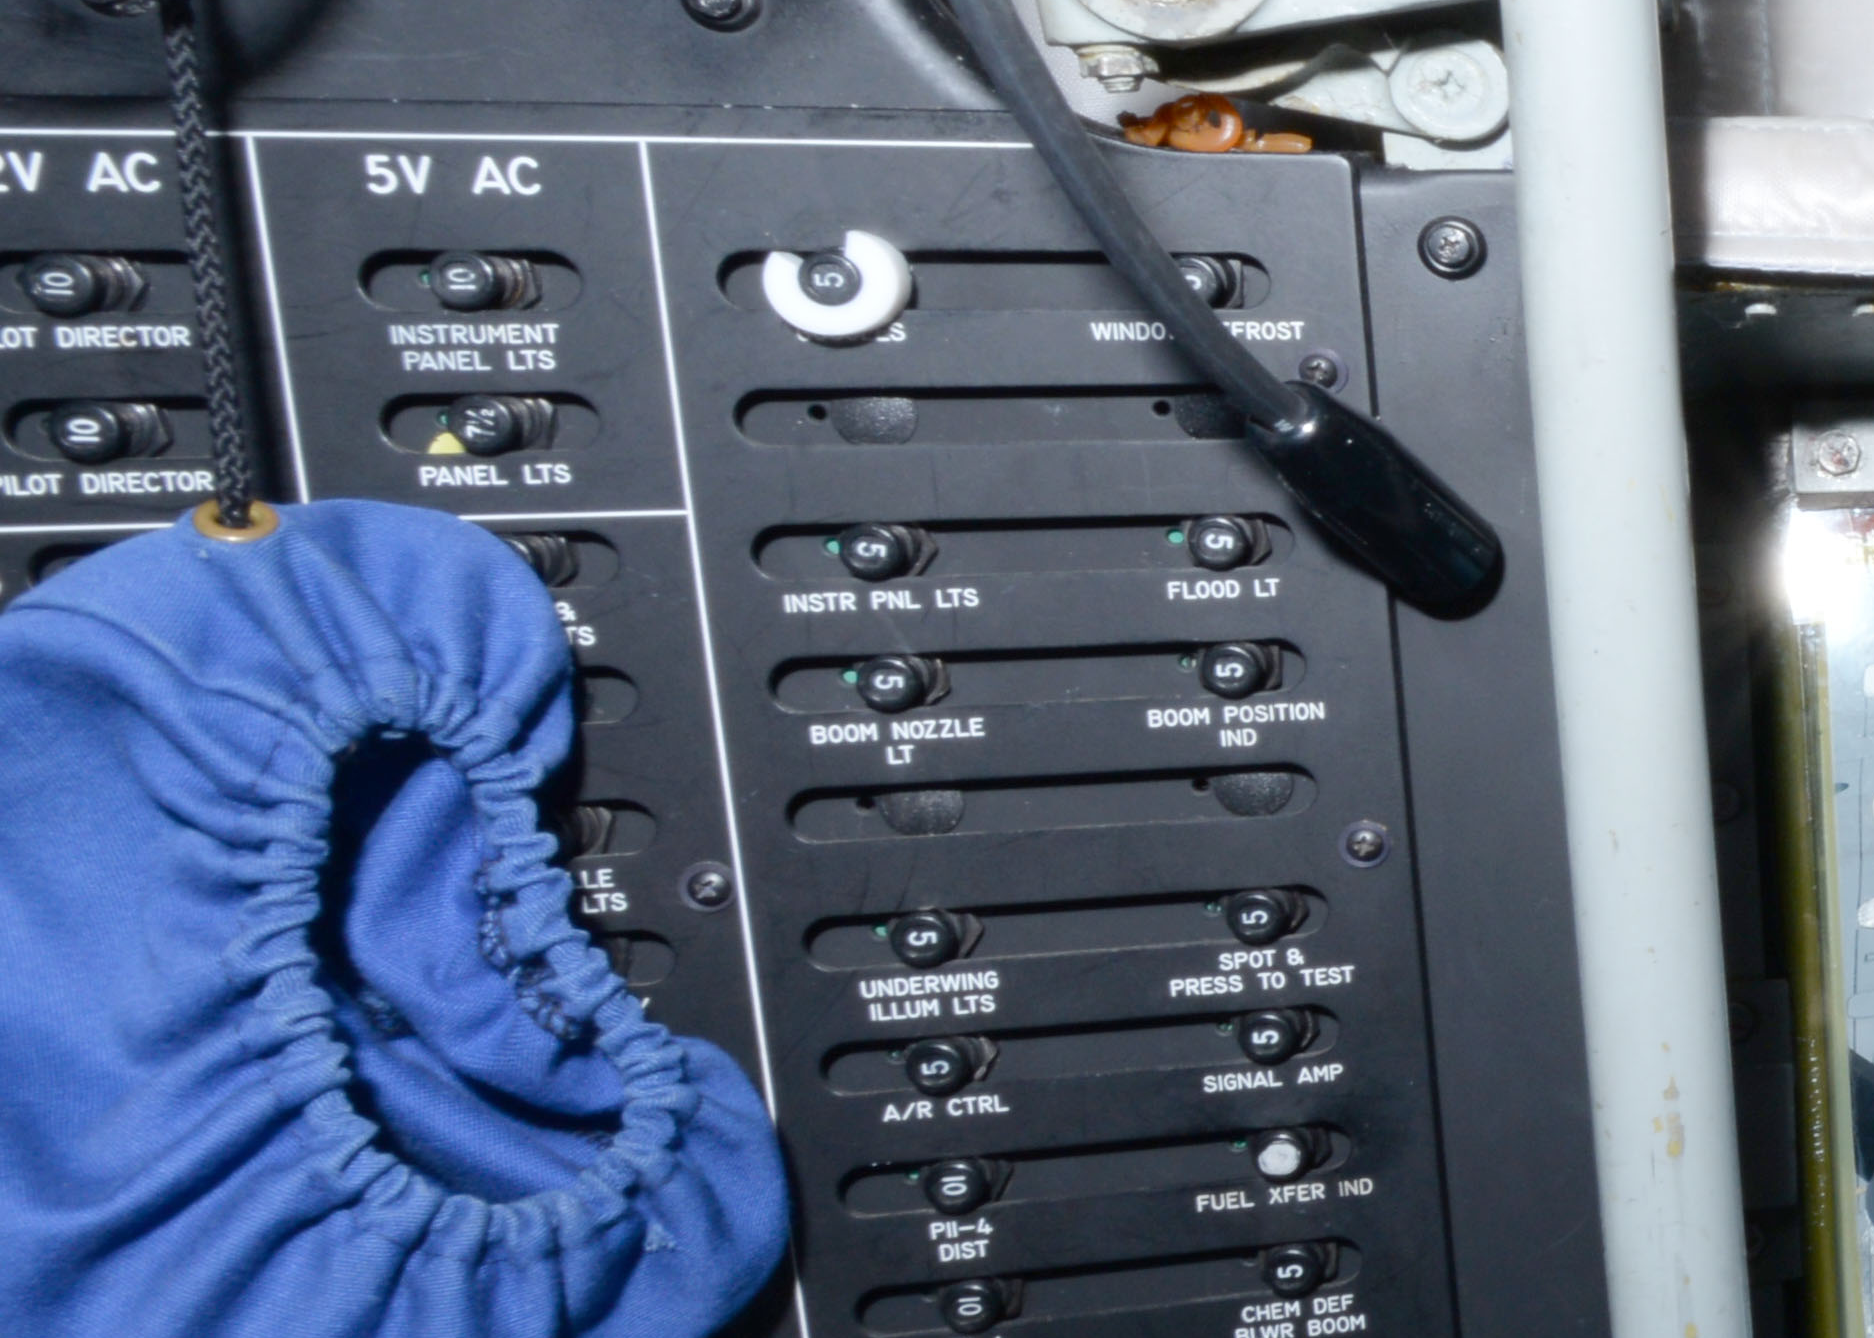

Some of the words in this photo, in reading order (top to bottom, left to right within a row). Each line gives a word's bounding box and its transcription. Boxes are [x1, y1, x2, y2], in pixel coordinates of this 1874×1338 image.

[87, 151, 161, 193] AC
[366, 155, 431, 195] 5V
[472, 157, 542, 196] AC
[55, 325, 191, 349] DIRECTOR
[389, 325, 559, 347] INSTRUMENT
[402, 351, 490, 372] PANEL
[508, 350, 556, 371] LTS
[79, 472, 215, 495] DIRECTOR
[420, 465, 508, 488] PANEL
[524, 462, 572, 485] LTS
[783, 590, 856, 613] INSTR
[870, 589, 921, 610] PNL
[936, 587, 979, 608] LTS
[1167, 580, 1240, 601] FLOOD
[1252, 578, 1280, 598] LT
[1147, 706, 1210, 729] BOOM
[1222, 701, 1325, 724] POSITION
[810, 723, 878, 746] BOOM
[892, 717, 986, 741] NOZZLE
[1219, 728, 1257, 748] IND
[887, 746, 914, 766] LT
[582, 892, 628, 914] LTS
[1218, 950, 1276, 972] SPOT
[1288, 948, 1304, 966] &
[860, 970, 1000, 1000] UNDERWING
[1169, 974, 1245, 998] PRESS
[1256, 970, 1286, 991] TO
[1299, 965, 1355, 988] TEST
[869, 998, 940, 1022] ILLUM
[953, 994, 996, 1017] LTS
[1203, 1069, 1281, 1094] SIGNAL
[1297, 1064, 1344, 1088] AMP
[882, 1099, 933, 1124] A/R
[947, 1097, 1010, 1121] CTRL
[1196, 1188, 1254, 1213] FUEL
[1269, 1182, 1325, 1205] XFER
[1337, 1177, 1374, 1198] IND
[938, 1239, 989, 1263] DIST
[1241, 1302, 1302, 1325] CHEM
[1314, 1294, 1355, 1316] DEF
[1307, 1314, 1367, 1338] BOOM
